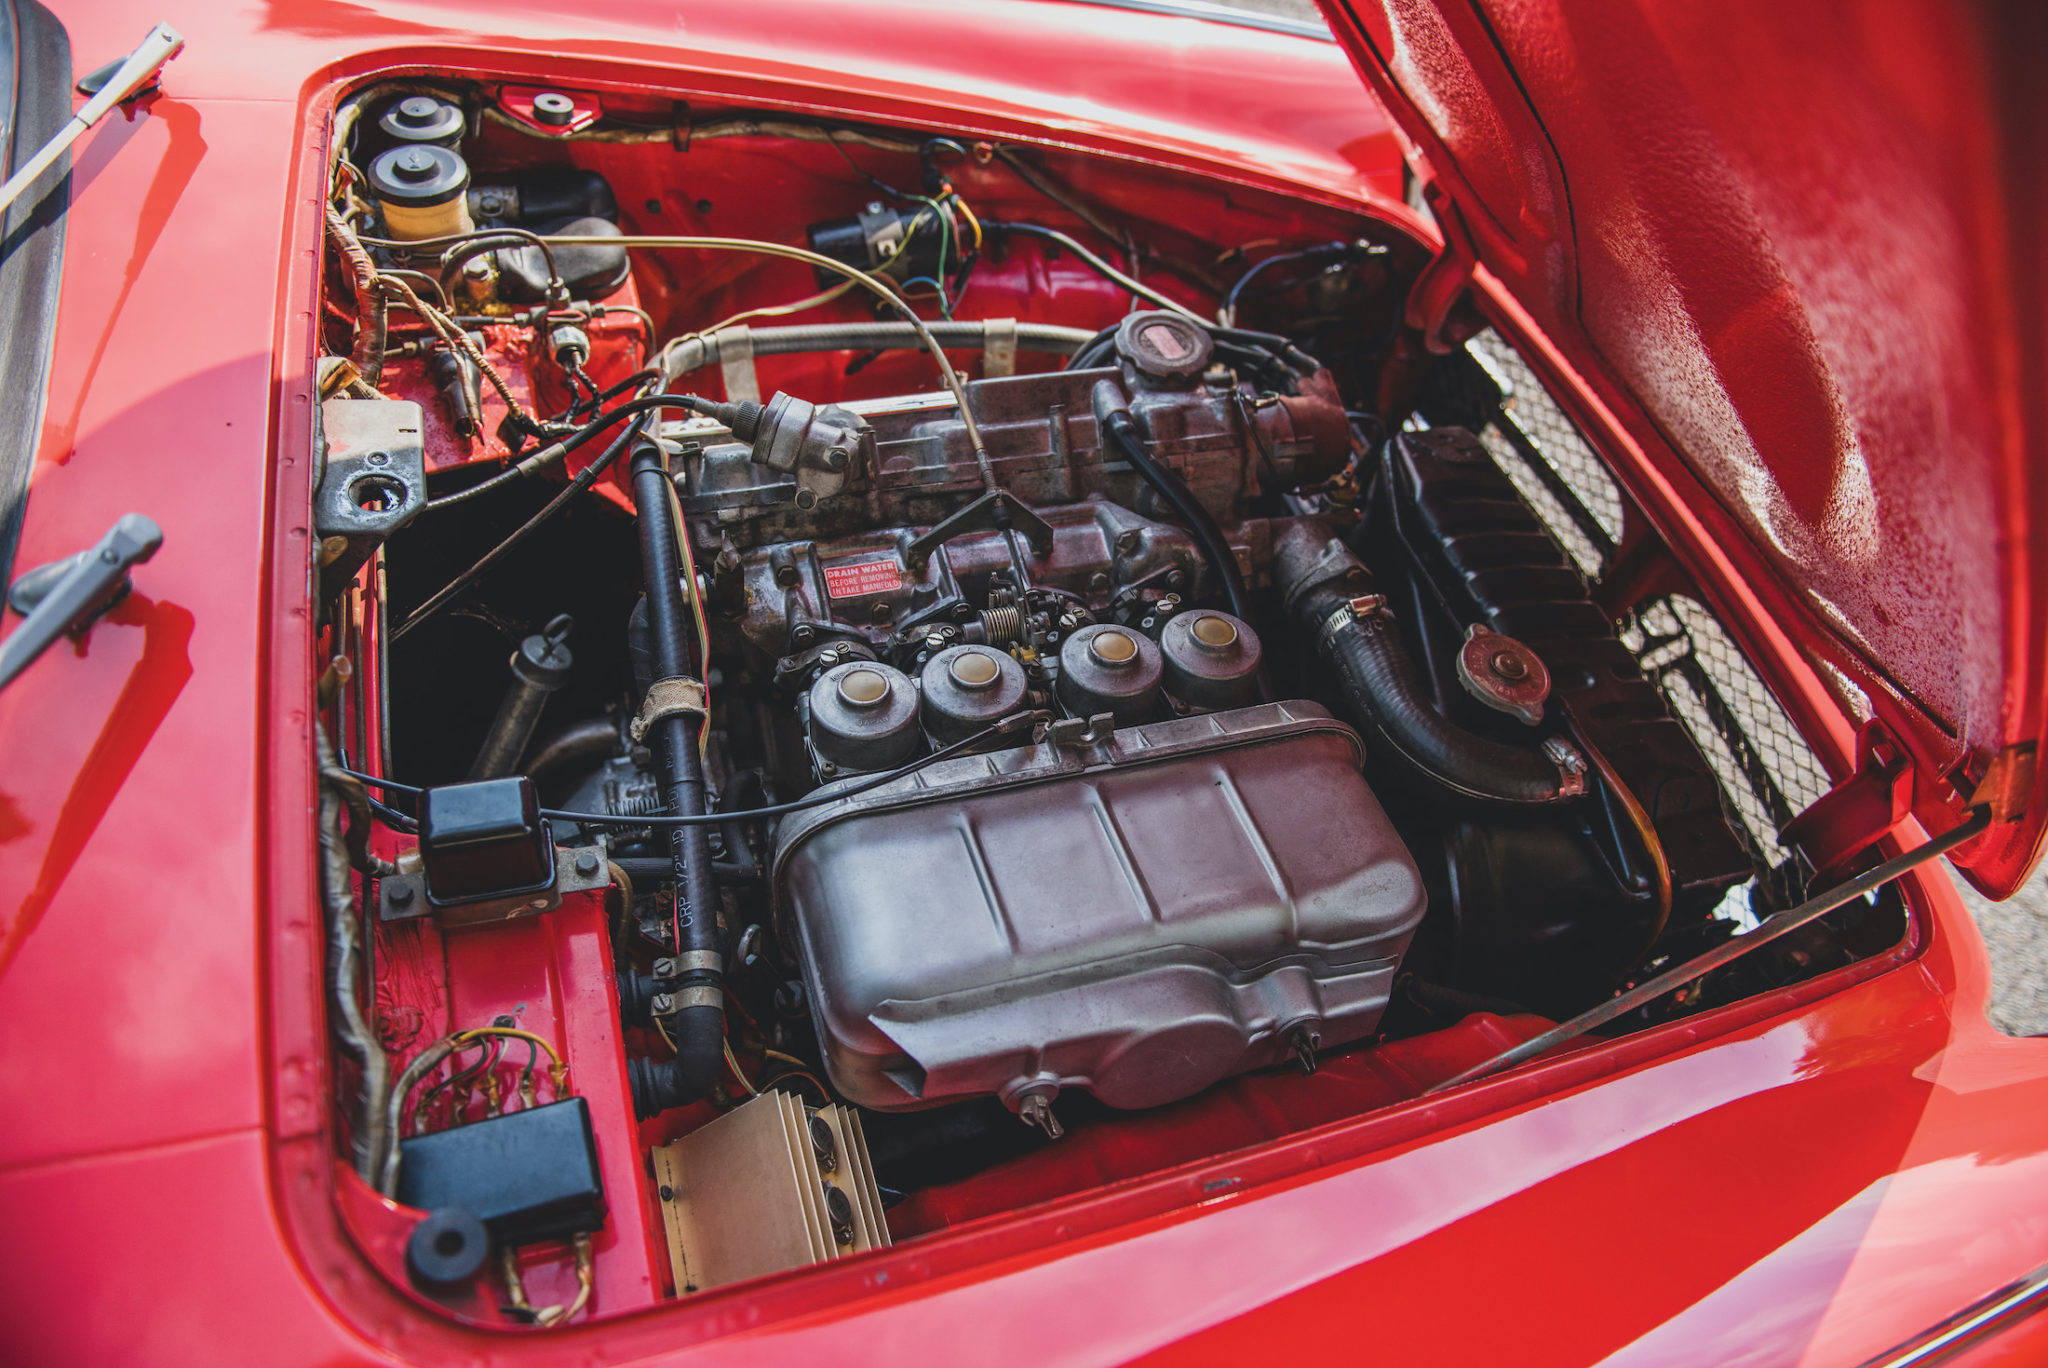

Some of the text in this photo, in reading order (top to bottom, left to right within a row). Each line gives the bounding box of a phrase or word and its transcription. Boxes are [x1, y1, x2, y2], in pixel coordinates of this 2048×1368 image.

[828, 563, 894, 578] DRAIN WATER
[830, 572, 896, 587] BEFORE REMOVING
[833, 580, 898, 595] INTAKE MANIFOLD
[672, 829, 685, 845] ID
[679, 896, 694, 928] CRP
